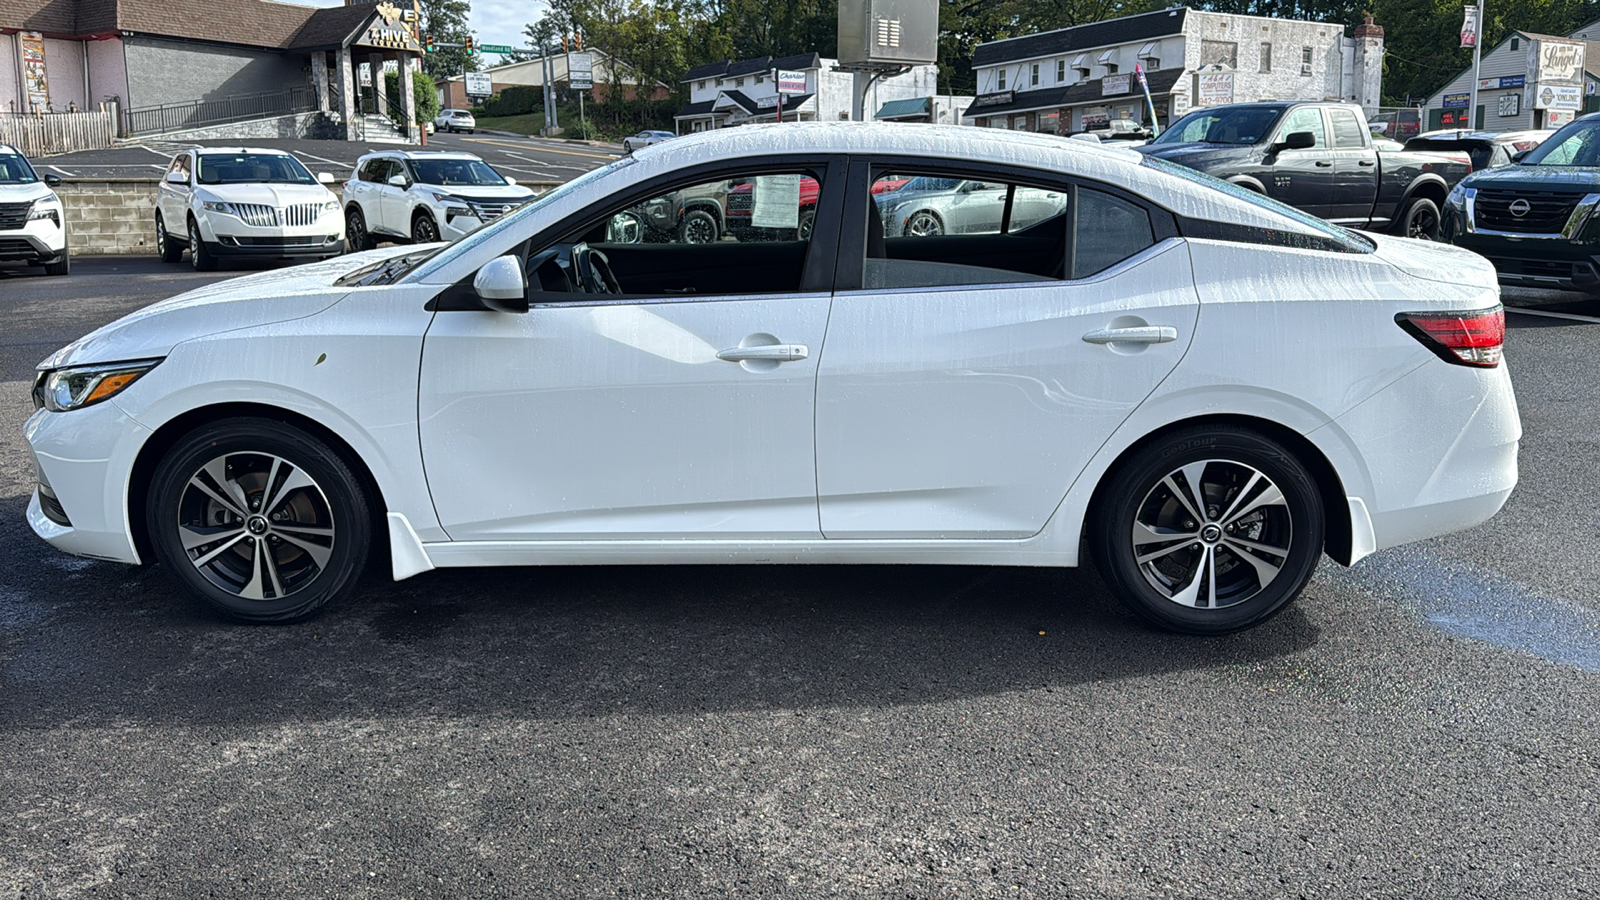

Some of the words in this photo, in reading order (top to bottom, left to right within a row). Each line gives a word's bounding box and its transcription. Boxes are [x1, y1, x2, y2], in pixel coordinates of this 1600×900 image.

[380, 28, 410, 43] HIVE
[1200, 82, 1232, 90] COMPUTERS
[1199, 96, 1233, 105] 942-9700
